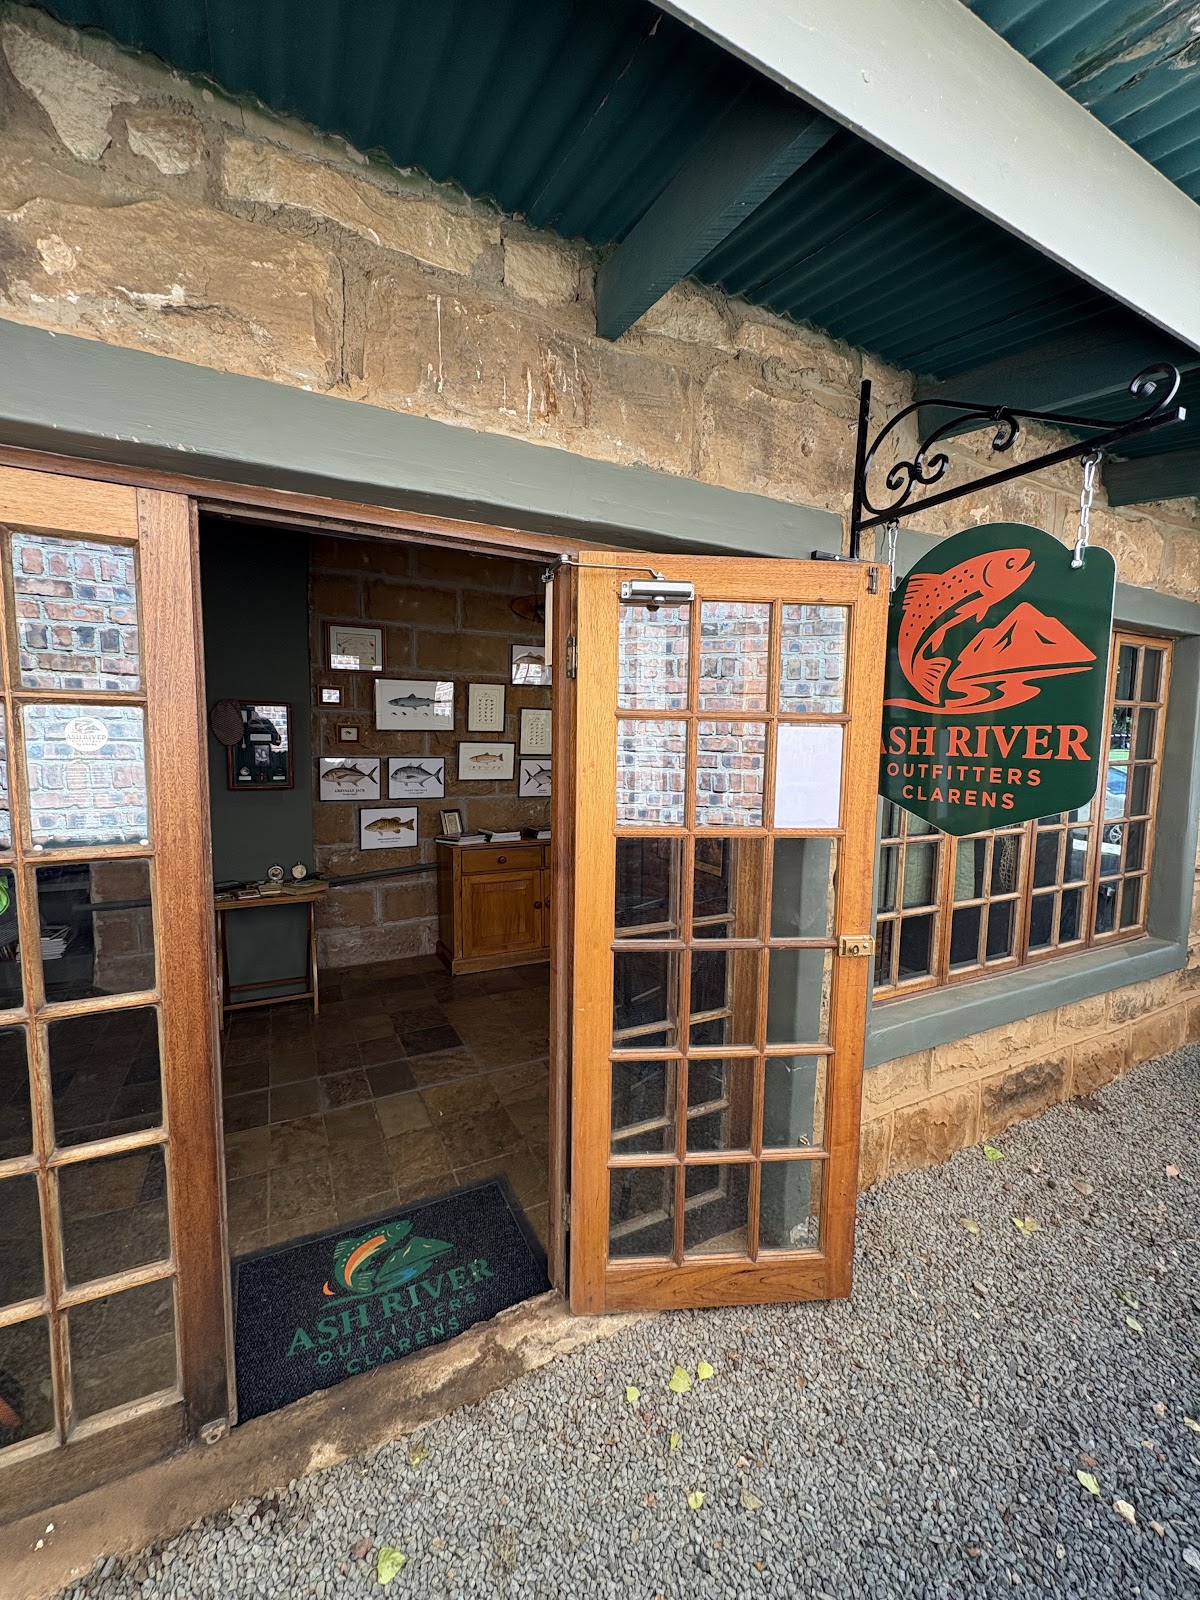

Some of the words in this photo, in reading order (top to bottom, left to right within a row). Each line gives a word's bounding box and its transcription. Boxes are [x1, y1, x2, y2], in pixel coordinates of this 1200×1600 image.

[880, 726, 937, 756] SH
[945, 724, 1091, 761] RIVER
[886, 762, 1041, 786] OUTFITTERS
[902, 784, 1015, 810] CLARENS
[286, 1303, 371, 1359] ASH
[380, 1258, 495, 1319] RIVER
[316, 1292, 478, 1366] OUTFITTERS
[346, 1316, 461, 1374] CLARENS
